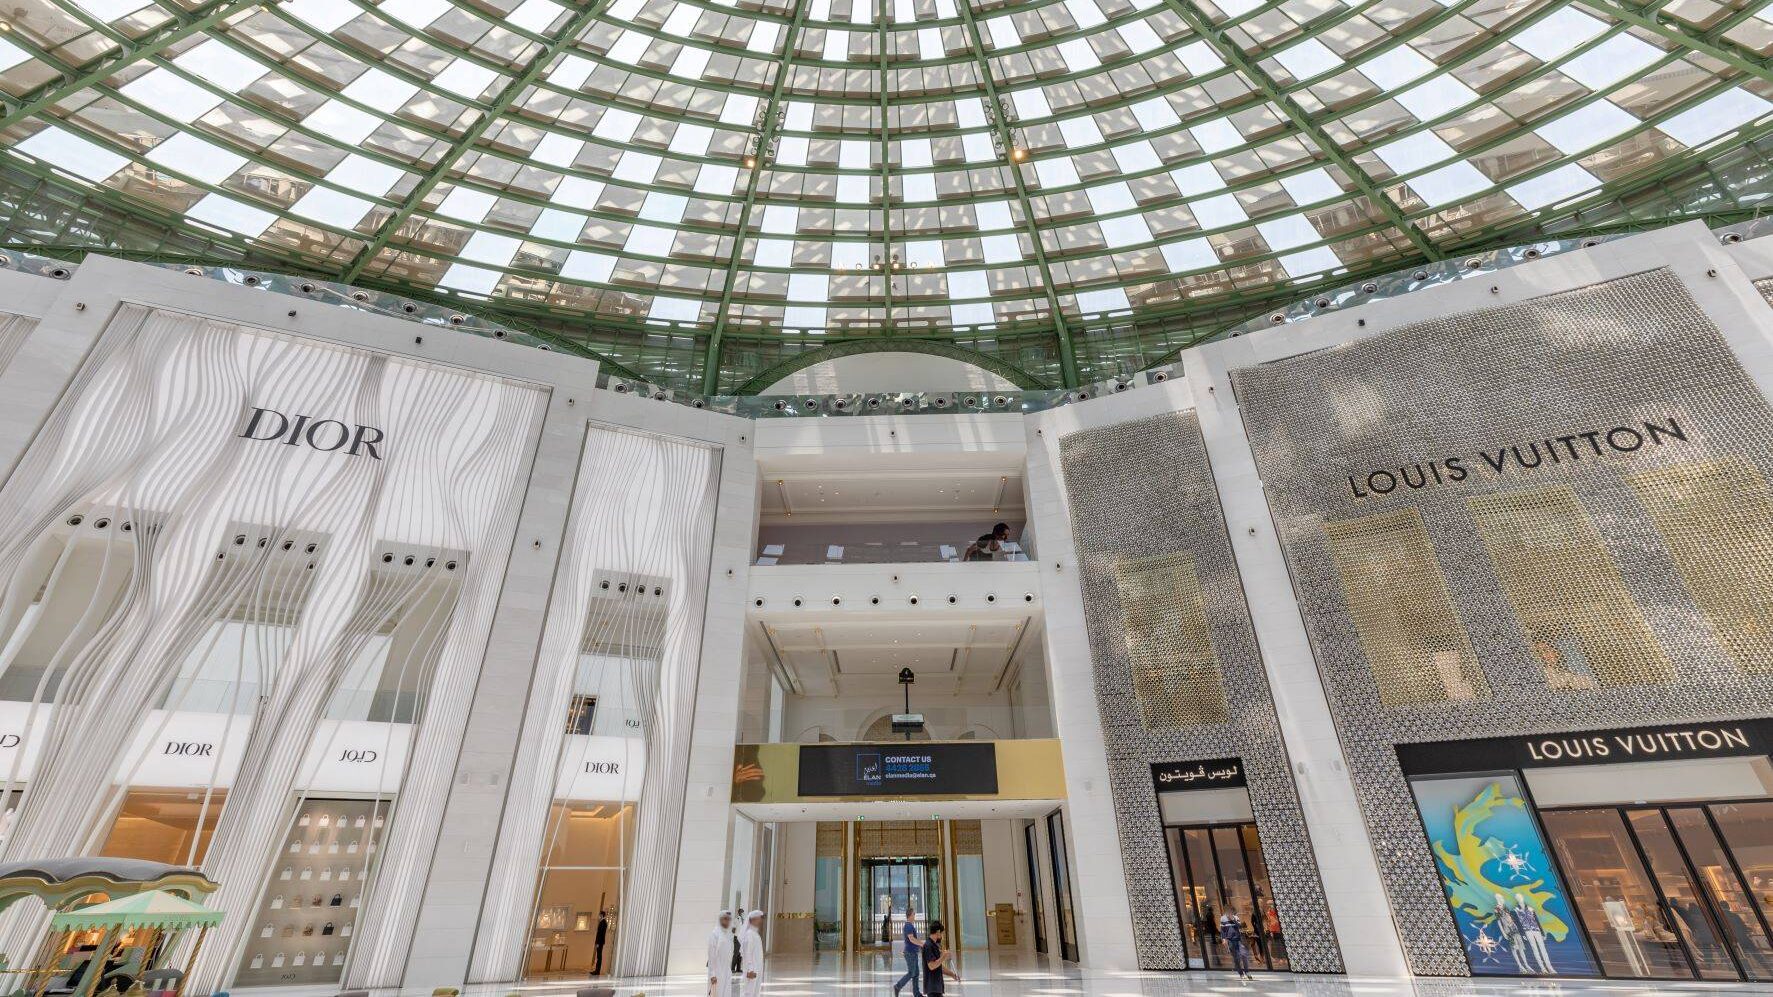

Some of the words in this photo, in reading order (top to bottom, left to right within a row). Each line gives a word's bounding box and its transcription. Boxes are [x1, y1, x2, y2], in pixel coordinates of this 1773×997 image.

[238, 406, 384, 461] DIOR
[1348, 457, 1468, 498] LOUIS
[1479, 417, 1689, 475] VUITTON
[163, 741, 213, 756] DIOR
[1527, 736, 1610, 760] LOUIS
[1614, 728, 1750, 755] VUITTON
[338, 749, 377, 763] ديور
[921, 755, 932, 763] US
[584, 761, 619, 775] DIOR
[1207, 765, 1238, 780] لويس
